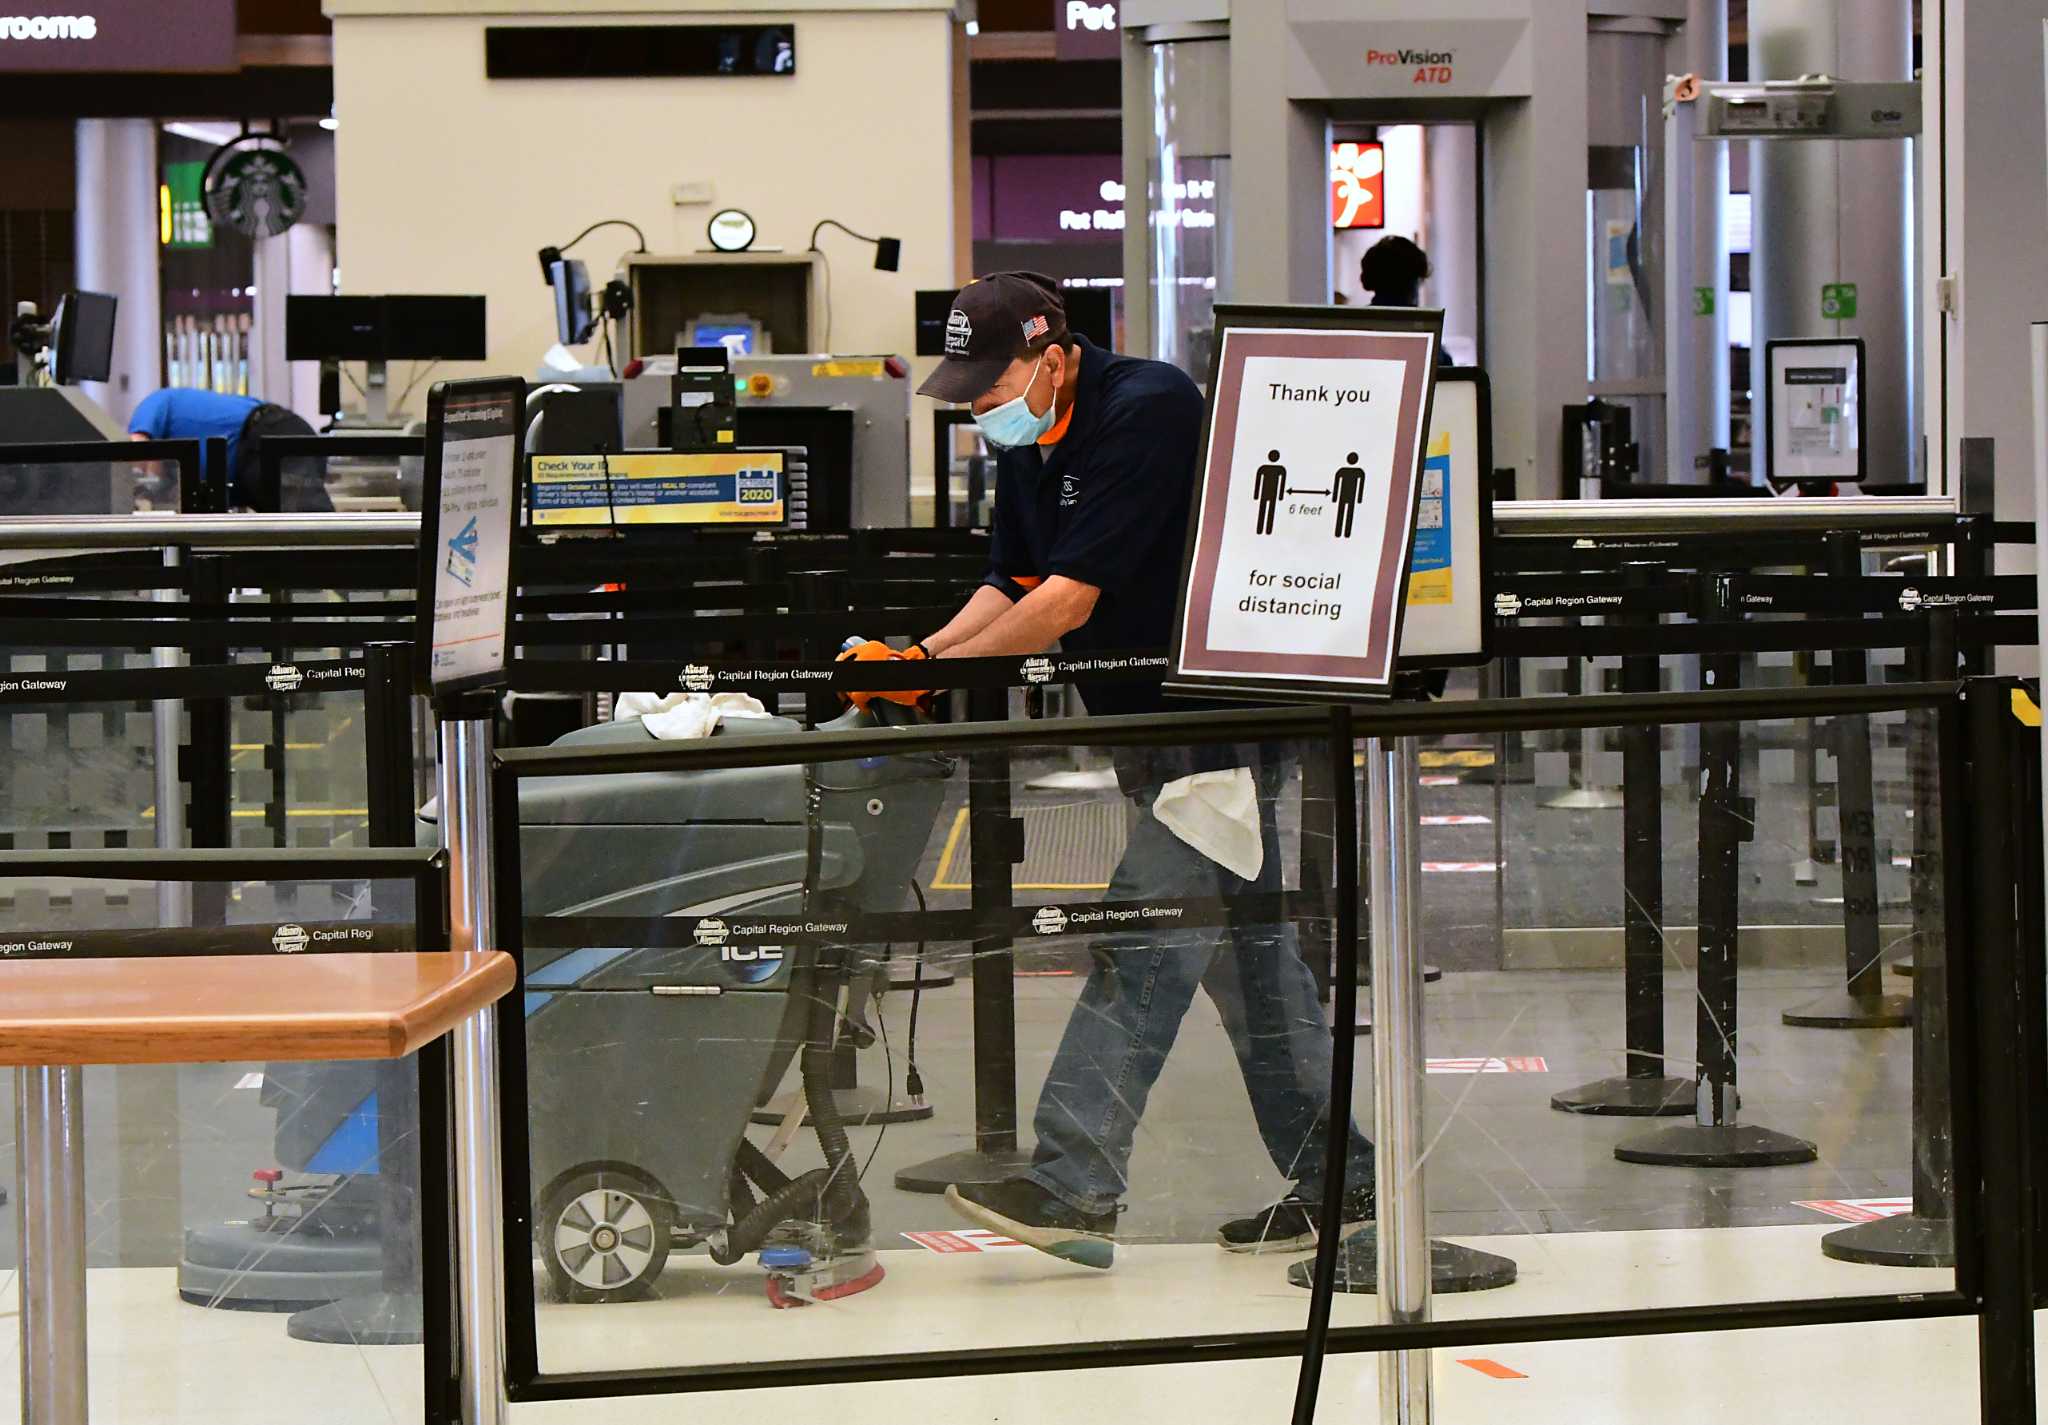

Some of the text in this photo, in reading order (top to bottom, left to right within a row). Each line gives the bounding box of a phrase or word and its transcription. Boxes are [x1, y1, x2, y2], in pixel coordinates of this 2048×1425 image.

[1067, 0, 1116, 31] Pet
[1366, 49, 1452, 65] ProVision
[1413, 66, 1452, 83] ATD
[1269, 383, 1371, 406] Thank you
[538, 461, 568, 471] Check
[571, 460, 595, 470] Your
[741, 489, 772, 500] 2020
[1288, 503, 1323, 516] 6 feet
[1248, 569, 1341, 590] for social
[1238, 596, 1342, 620] distancing
[1524, 597, 1554, 608] Capital
[1555, 596, 1584, 606] Region
[1586, 595, 1623, 605] Gateway
[1058, 659, 1091, 672] Capital
[1094, 659, 1127, 671] Region
[1129, 656, 1169, 668] Gateway
[306, 667, 342, 680] Capital
[718, 670, 751, 682] Capital
[754, 669, 789, 682] Region
[790, 669, 834, 681] Gateway
[21, 679, 67, 691] Gateway
[1070, 911, 1104, 923] Capital
[1105, 909, 1140, 921] Region
[1141, 906, 1183, 918] Gateway
[312, 928, 348, 942] Capital
[732, 924, 767, 936] Capital
[768, 923, 803, 936] Region
[805, 922, 848, 934] Gateway
[27, 940, 73, 952] Gateway
